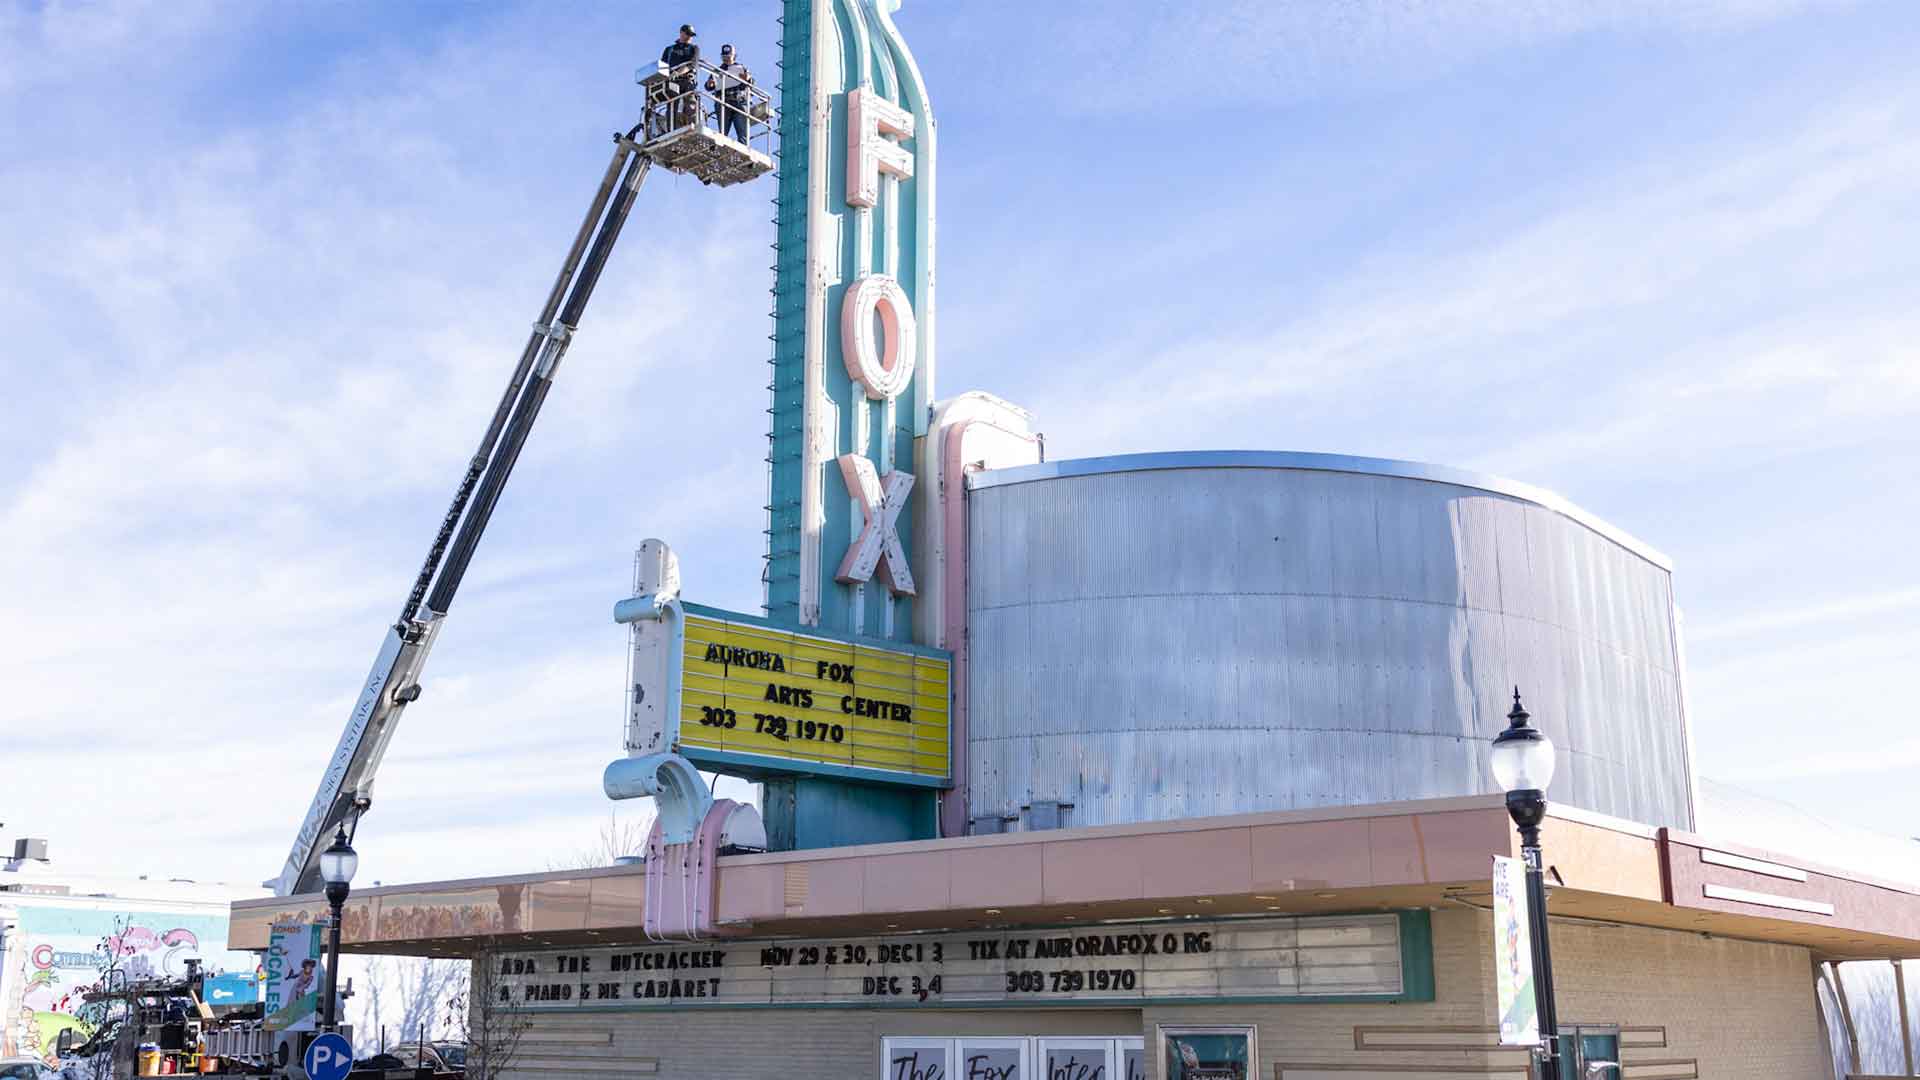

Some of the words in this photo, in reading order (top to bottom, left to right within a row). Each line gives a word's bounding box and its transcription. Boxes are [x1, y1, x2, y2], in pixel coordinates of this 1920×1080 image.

[834, 87, 918, 598] FOX
[704, 643, 785, 673] AURORA
[816, 661, 855, 684] FOX
[764, 683, 813, 709] ARTS
[840, 695, 912, 723] CENTER
[700, 705, 737, 729] 303
[754, 713, 788, 736] 739
[796, 719, 844, 744] 1970
[501, 958, 536, 976] ADA
[557, 956, 591, 974] THE
[610, 951, 726, 972] NUTCRACKER
[761, 947, 794, 967] NOV
[798, 946, 819, 966] 29
[968, 940, 1001, 961] TIX
[1006, 939, 1030, 960] AT
[266, 935, 285, 1014] LOCALES
[862, 976, 902, 996] DEC
[1006, 971, 1044, 992] 303
[1050, 971, 1084, 992] 739
[1088, 969, 1137, 991] 1970
[525, 983, 572, 1001] PIANO
[598, 982, 620, 1000] ME
[633, 978, 721, 999] CABARET
[312, 1046, 332, 1075] P
[893, 1051, 944, 1080] The
